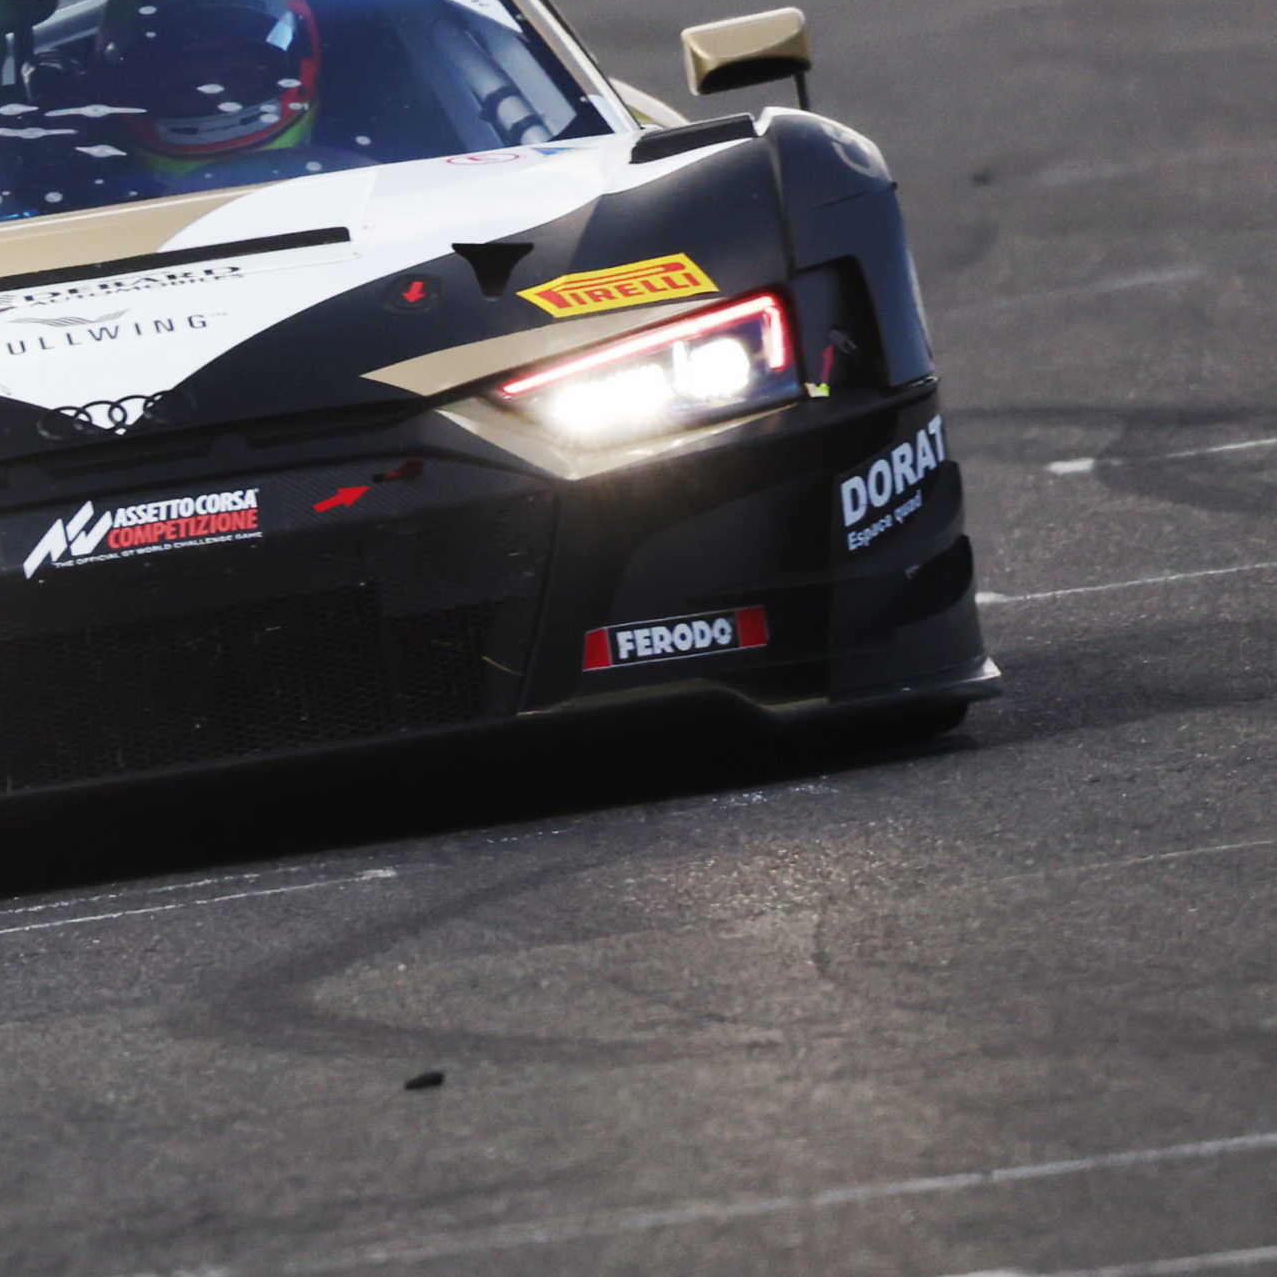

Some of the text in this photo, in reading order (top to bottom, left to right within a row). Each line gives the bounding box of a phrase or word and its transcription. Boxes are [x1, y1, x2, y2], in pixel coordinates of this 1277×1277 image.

[535, 261, 701, 309] PIRELLI
[839, 413, 947, 527] DORAT
[107, 508, 259, 550] COMPETIZIONE
[113, 488, 259, 528] ASSETTO CORSA
[616, 616, 733, 662] FERODO
